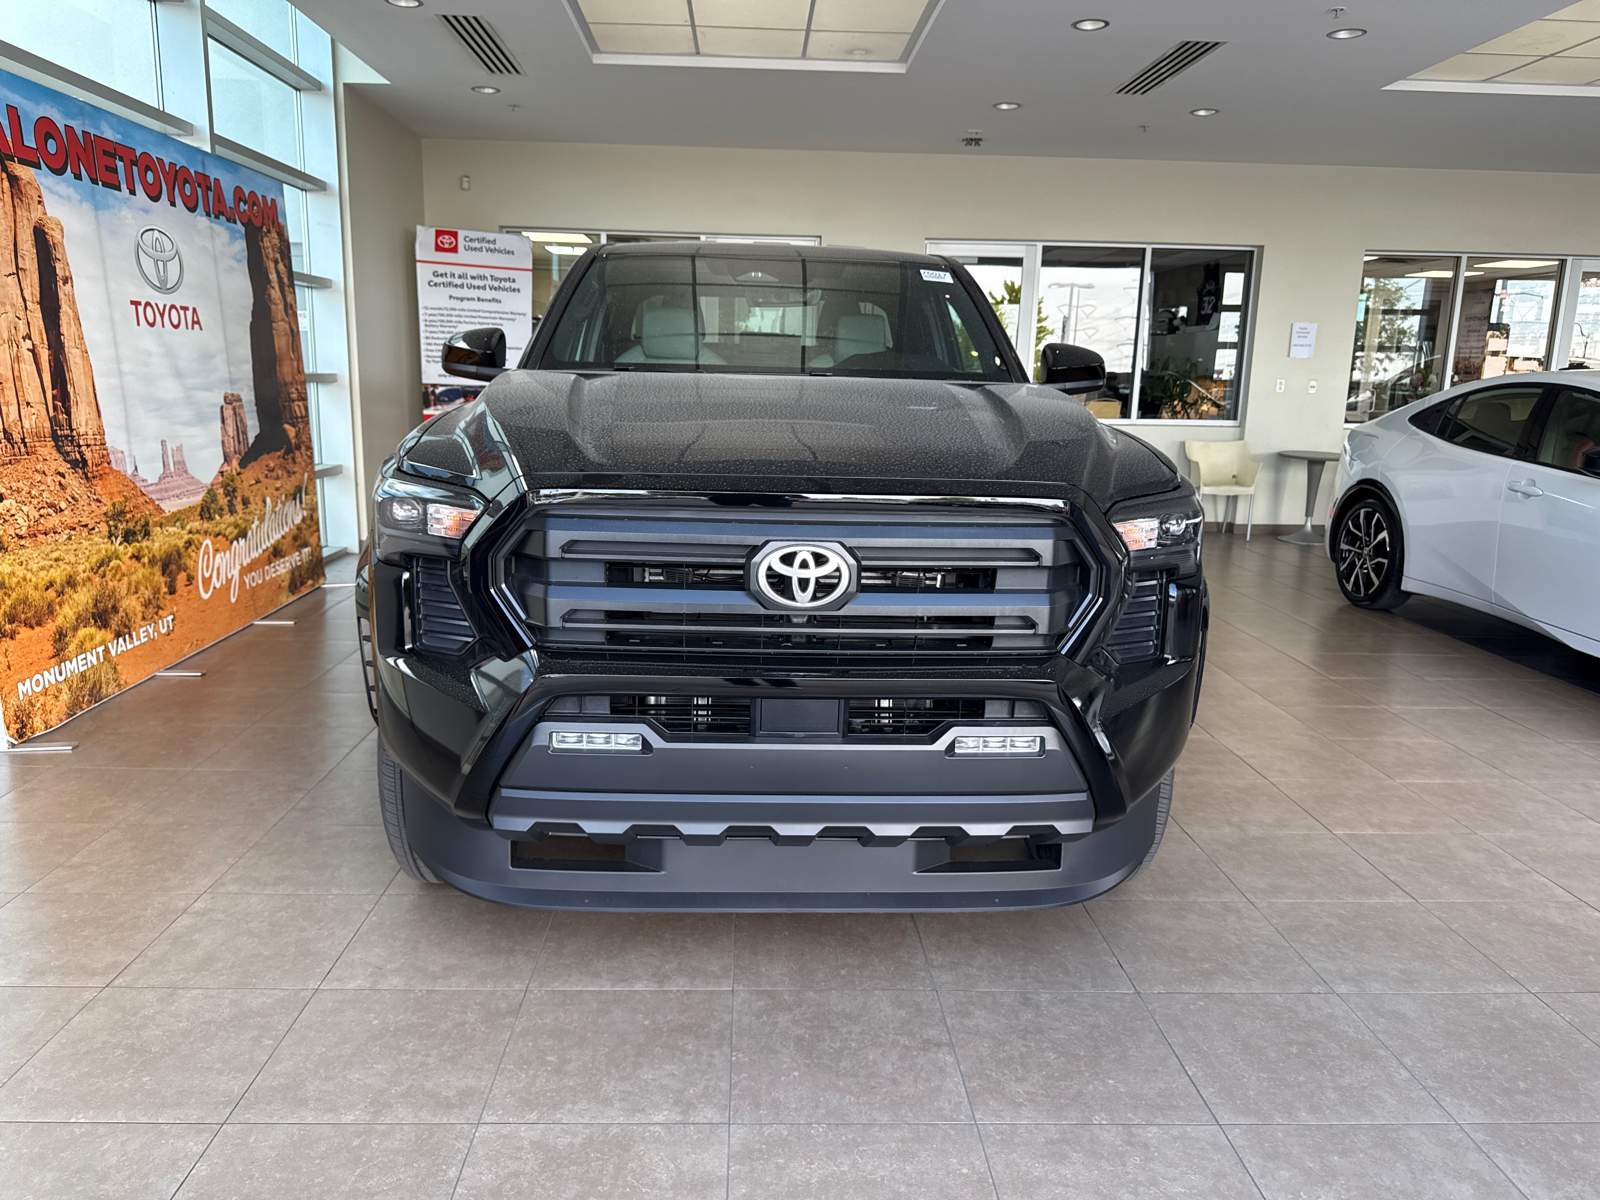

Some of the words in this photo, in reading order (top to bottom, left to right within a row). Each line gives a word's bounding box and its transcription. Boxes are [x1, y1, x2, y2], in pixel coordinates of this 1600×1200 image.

[463, 235, 497, 245] Certified
[463, 244, 483, 252] Used
[484, 246, 515, 256] Vehicles
[432, 270, 448, 278] Get
[449, 271, 456, 279] it
[457, 272, 468, 280] all
[469, 273, 488, 281] with
[489, 275, 516, 284] Toyota
[427, 280, 465, 289] Certified
[466, 282, 486, 291] Used
[488, 284, 521, 293] Vehicles
[448, 295, 476, 303] Program
[476, 296, 502, 304] Benefits
[129, 299, 203, 331] TOYOTA
[198, 472, 308, 603] Congratulations!
[243, 568, 263, 590] YOU
[264, 551, 302, 581] DESERVE
[301, 546, 313, 563] IT!
[17, 645, 105, 701] MONUMENT
[107, 622, 158, 657] VALLEY,
[158, 614, 175, 634] UT
